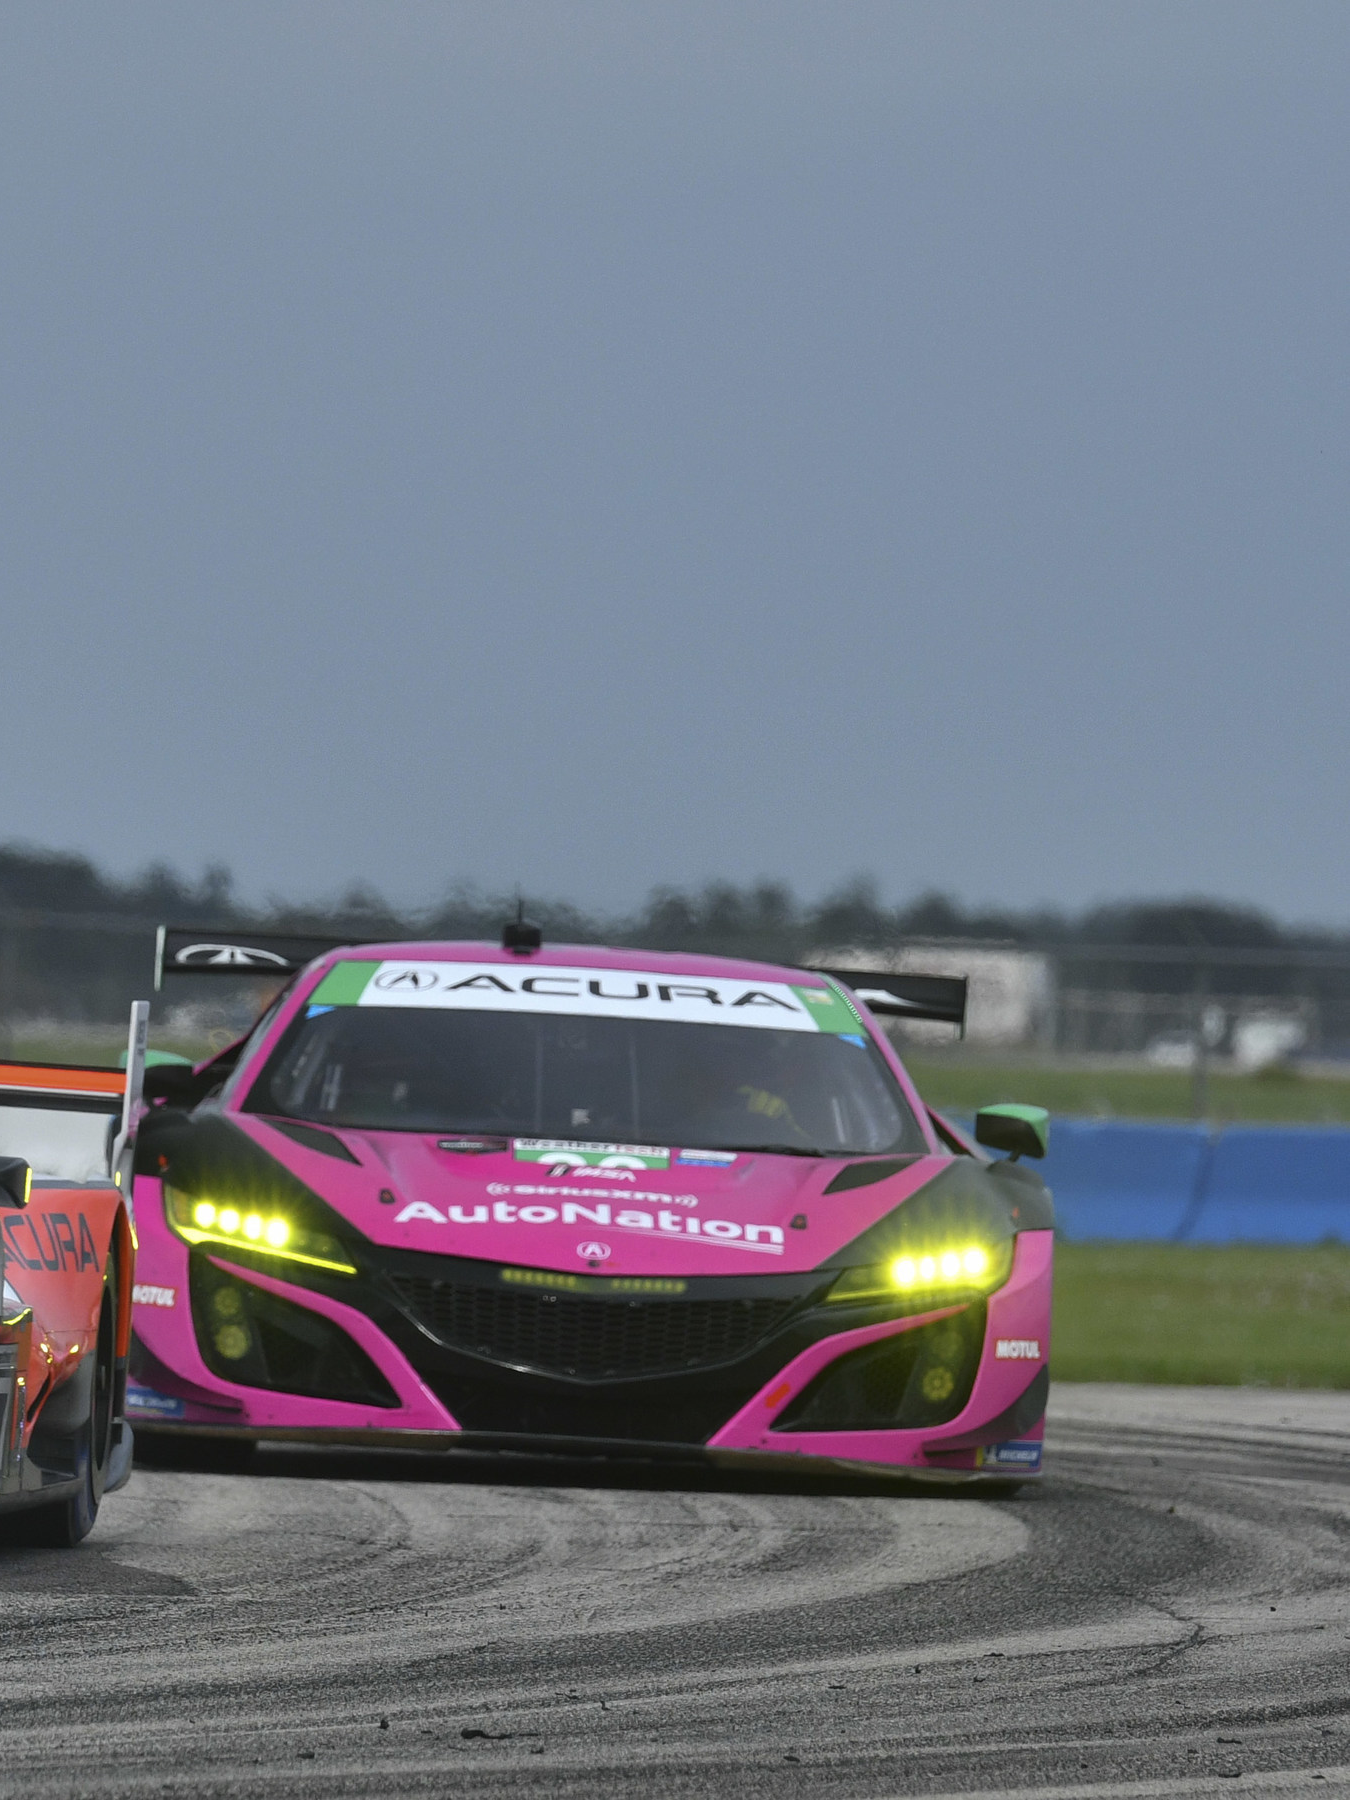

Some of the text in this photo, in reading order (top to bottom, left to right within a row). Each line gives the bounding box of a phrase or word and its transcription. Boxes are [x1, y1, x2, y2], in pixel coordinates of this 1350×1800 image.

[445, 974, 801, 1012] ACURA
[393, 1200, 785, 1244] AutoNation
[995, 1340, 1041, 1359] MOTUL
